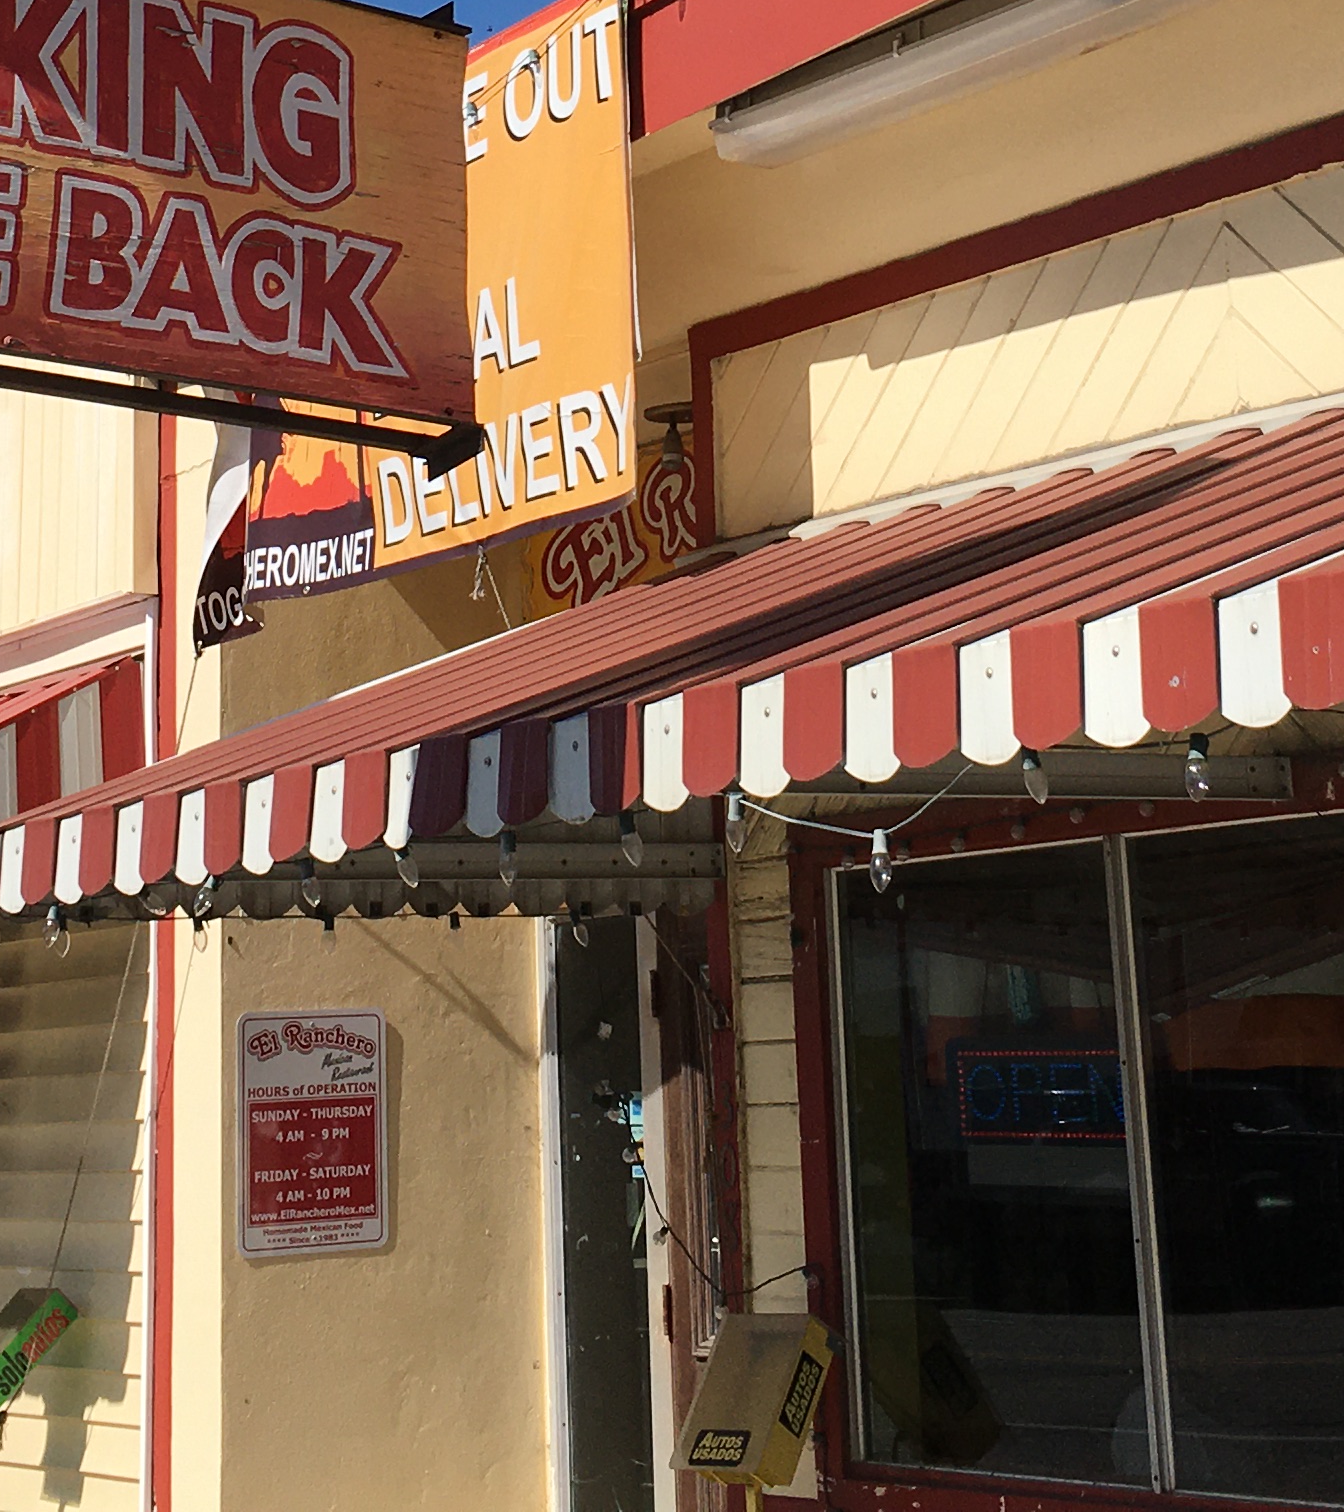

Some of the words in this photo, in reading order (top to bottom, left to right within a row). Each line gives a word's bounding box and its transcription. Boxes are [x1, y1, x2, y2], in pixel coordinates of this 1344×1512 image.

[504, 4, 620, 142] OUT
[48, 171, 410, 379] BACK
[378, 371, 632, 548] DELIVERY
[247, 1029, 282, 1061] El
[282, 1021, 375, 1059] Ranchero
[248, 1086, 290, 1099] HOURS
[293, 1085, 305, 1097] of
[307, 1081, 376, 1096] OPERATION
[965, 1062, 1126, 1124] OPEN
[252, 1109, 300, 1123] SUNDAY
[311, 1105, 373, 1119] THURSDAY
[276, 1131, 284, 1143] 4
[286, 1130, 304, 1142] AM
[321, 1128, 329, 1140] 9
[332, 1127, 349, 1139] PM
[254, 1169, 299, 1183] FRIDAY
[309, 1164, 371, 1179] SATURDAY
[276, 1191, 283, 1203] 4
[286, 1190, 304, 1202] AM
[316, 1189, 330, 1200] 10
[333, 1187, 350, 1199] PM
[251, 1203, 375, 1222] www.ElRancheroMex.net
[310, 1223, 343, 1233] Mexican
[344, 1221, 364, 1230] Food
[699, 1432, 744, 1448] AUTOS
[692, 1448, 743, 1461] USADOS
